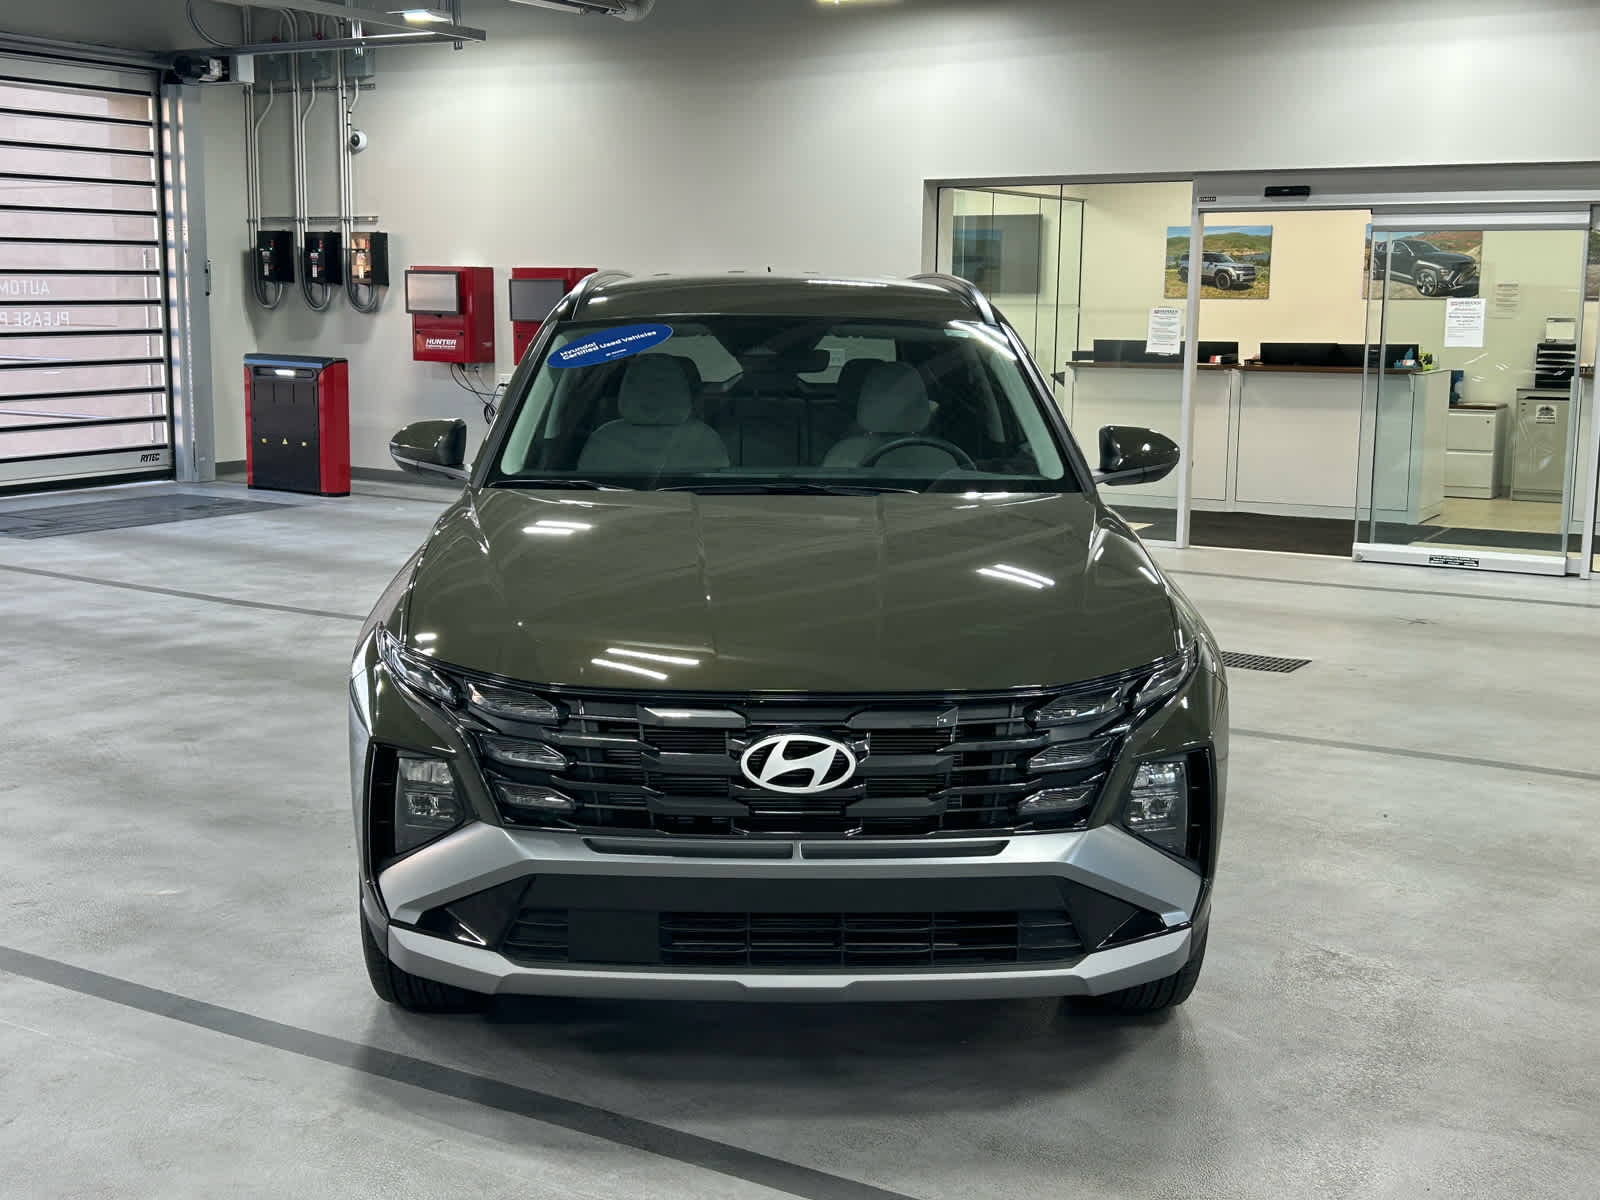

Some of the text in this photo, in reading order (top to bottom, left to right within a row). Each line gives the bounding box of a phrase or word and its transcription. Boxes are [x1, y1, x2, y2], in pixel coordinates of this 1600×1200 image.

[426, 338, 457, 346] HUNTER
[560, 341, 596, 356] Hyundai
[563, 345, 599, 360] Certified
[600, 338, 621, 348] Used
[620, 332, 657, 342] Vehicles
[140, 452, 161, 463] RYTEC
